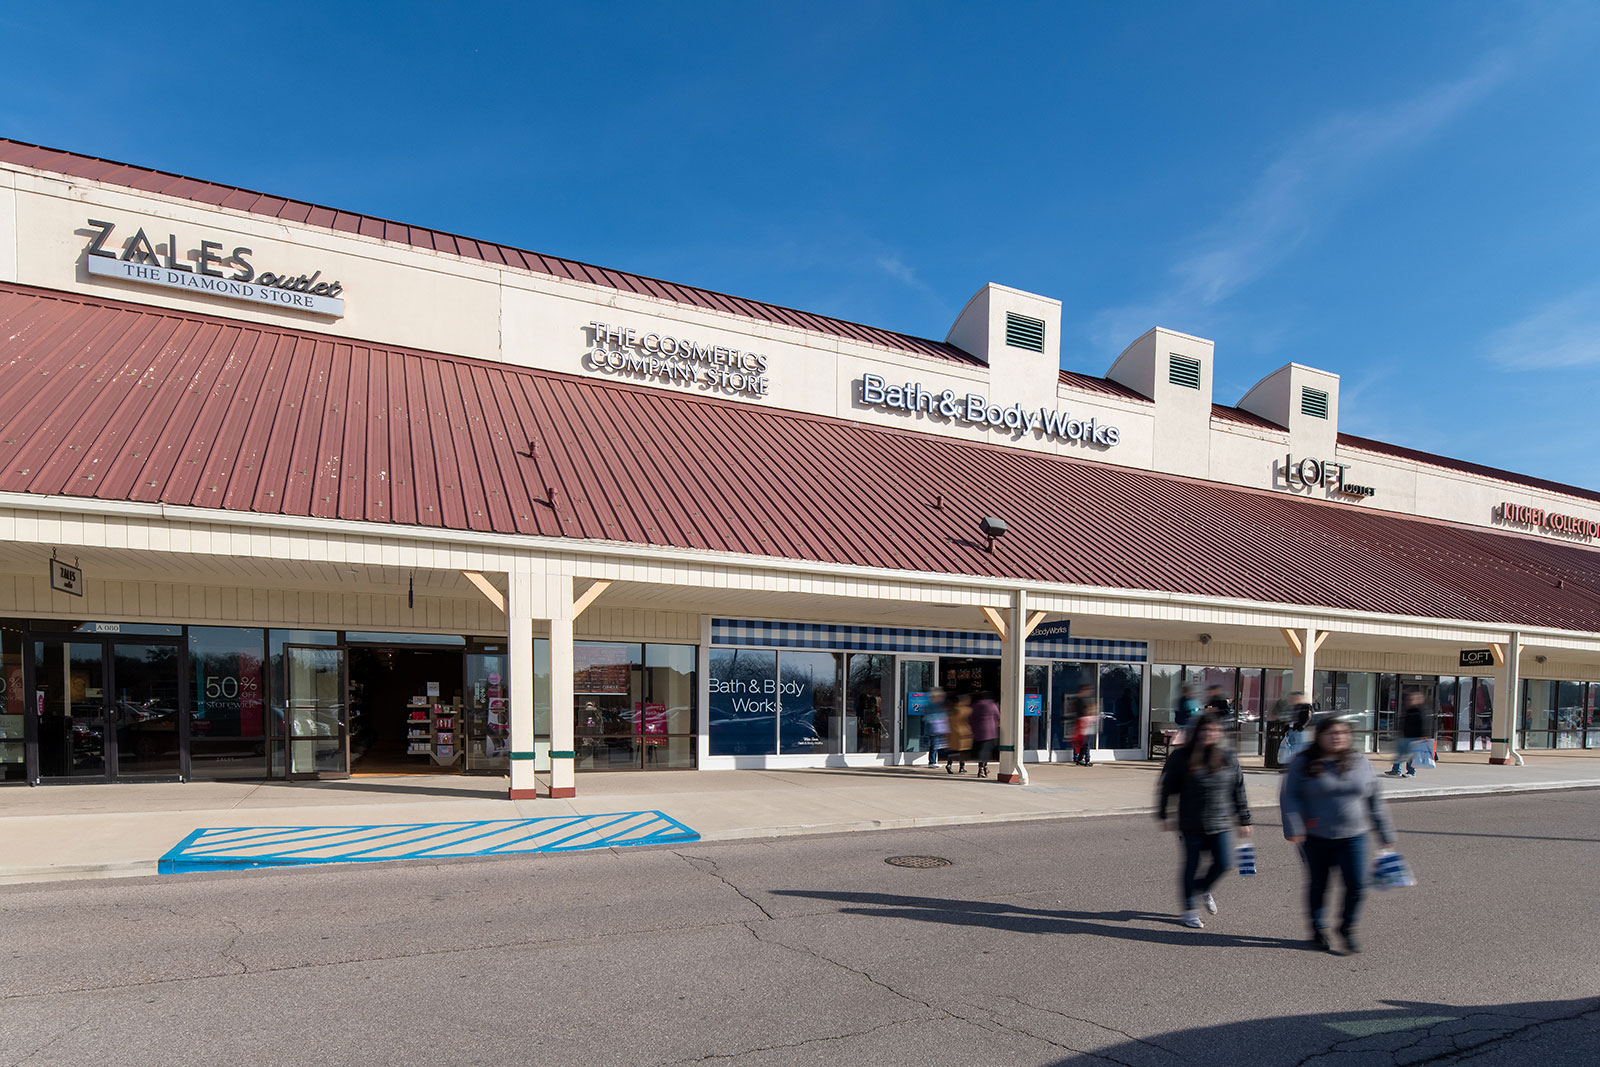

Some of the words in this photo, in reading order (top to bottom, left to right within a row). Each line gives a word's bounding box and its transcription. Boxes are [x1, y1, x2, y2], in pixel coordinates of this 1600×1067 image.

[87, 218, 255, 282] ZALES
[259, 270, 344, 298] outlet
[123, 263, 161, 281] THE
[167, 272, 254, 297] DIAMOND
[260, 288, 314, 308] STORE
[590, 320, 636, 348] THE
[643, 332, 769, 374] COSMETICS
[590, 347, 702, 383] COMPANY
[707, 367, 769, 396] STORE
[862, 373, 934, 414] Bath
[938, 389, 962, 419] &
[965, 393, 1039, 436] Body
[1040, 407, 1121, 447] Works
[1285, 453, 1352, 491] LOFT
[1501, 502, 1546, 526] KITCHEN
[60, 567, 76, 581] ZALES
[1035, 628, 1050, 637] Body
[1050, 626, 1068, 635] Works
[1462, 652, 1490, 661] LOFT
[709, 678, 746, 694] Bath
[749, 679, 761, 693] &
[732, 698, 783, 713] Works
